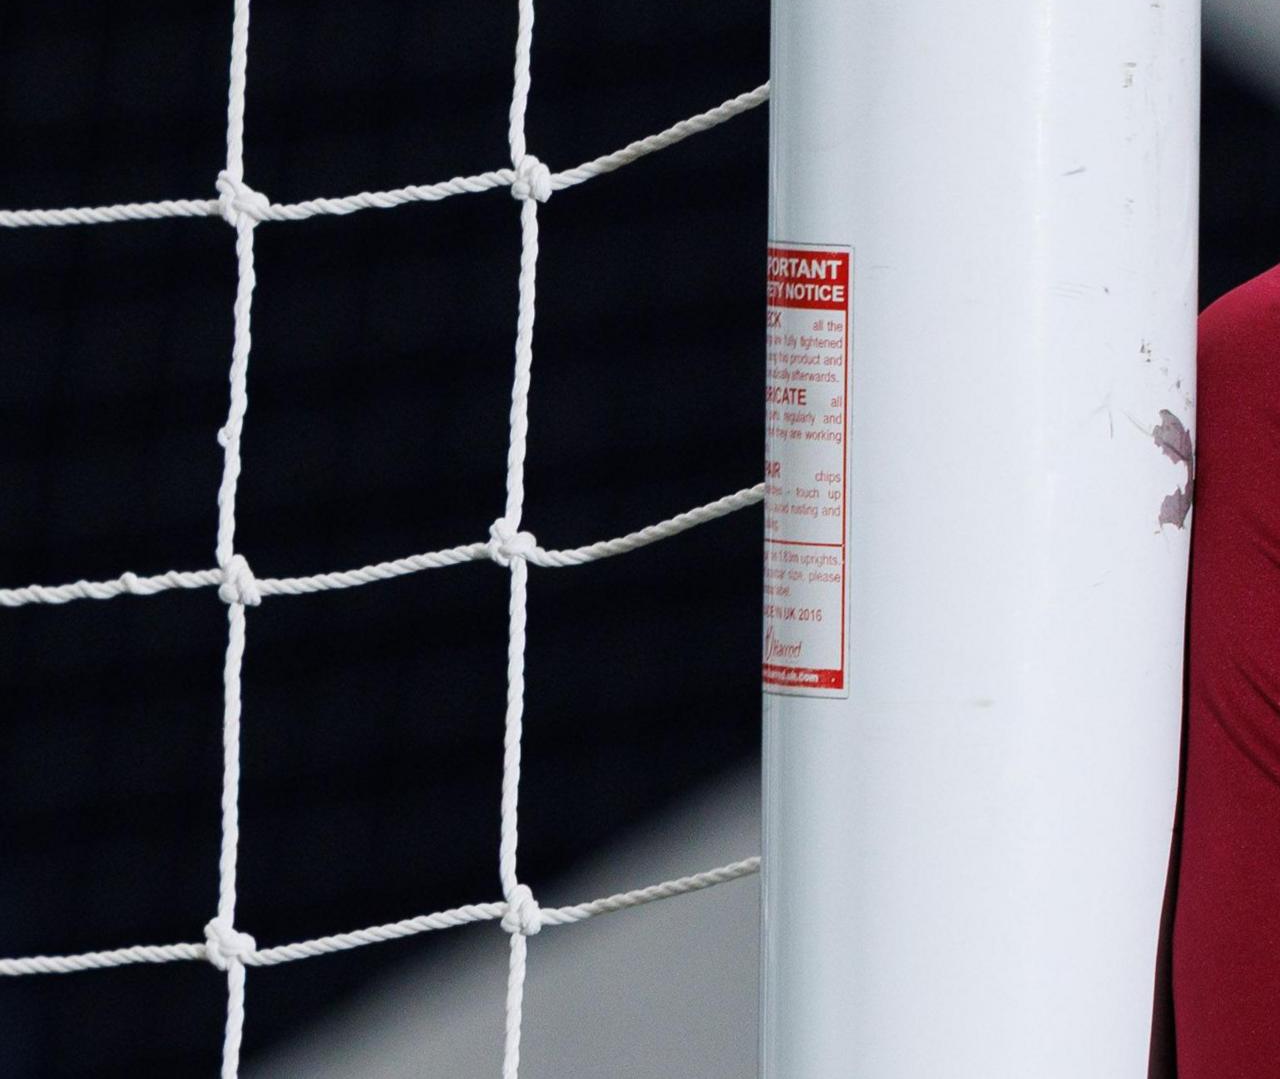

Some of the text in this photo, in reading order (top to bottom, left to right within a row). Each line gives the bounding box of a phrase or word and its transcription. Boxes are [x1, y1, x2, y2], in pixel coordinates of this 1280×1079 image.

[786, 283, 844, 302] NOTICE
[827, 321, 842, 332] the
[824, 355, 842, 366] and
[830, 396, 842, 408] all
[823, 413, 842, 424] and
[805, 430, 842, 444] working
[815, 470, 840, 485] chips
[827, 489, 840, 501] up
[821, 506, 840, 516] and
[798, 608, 822, 621] 2016
